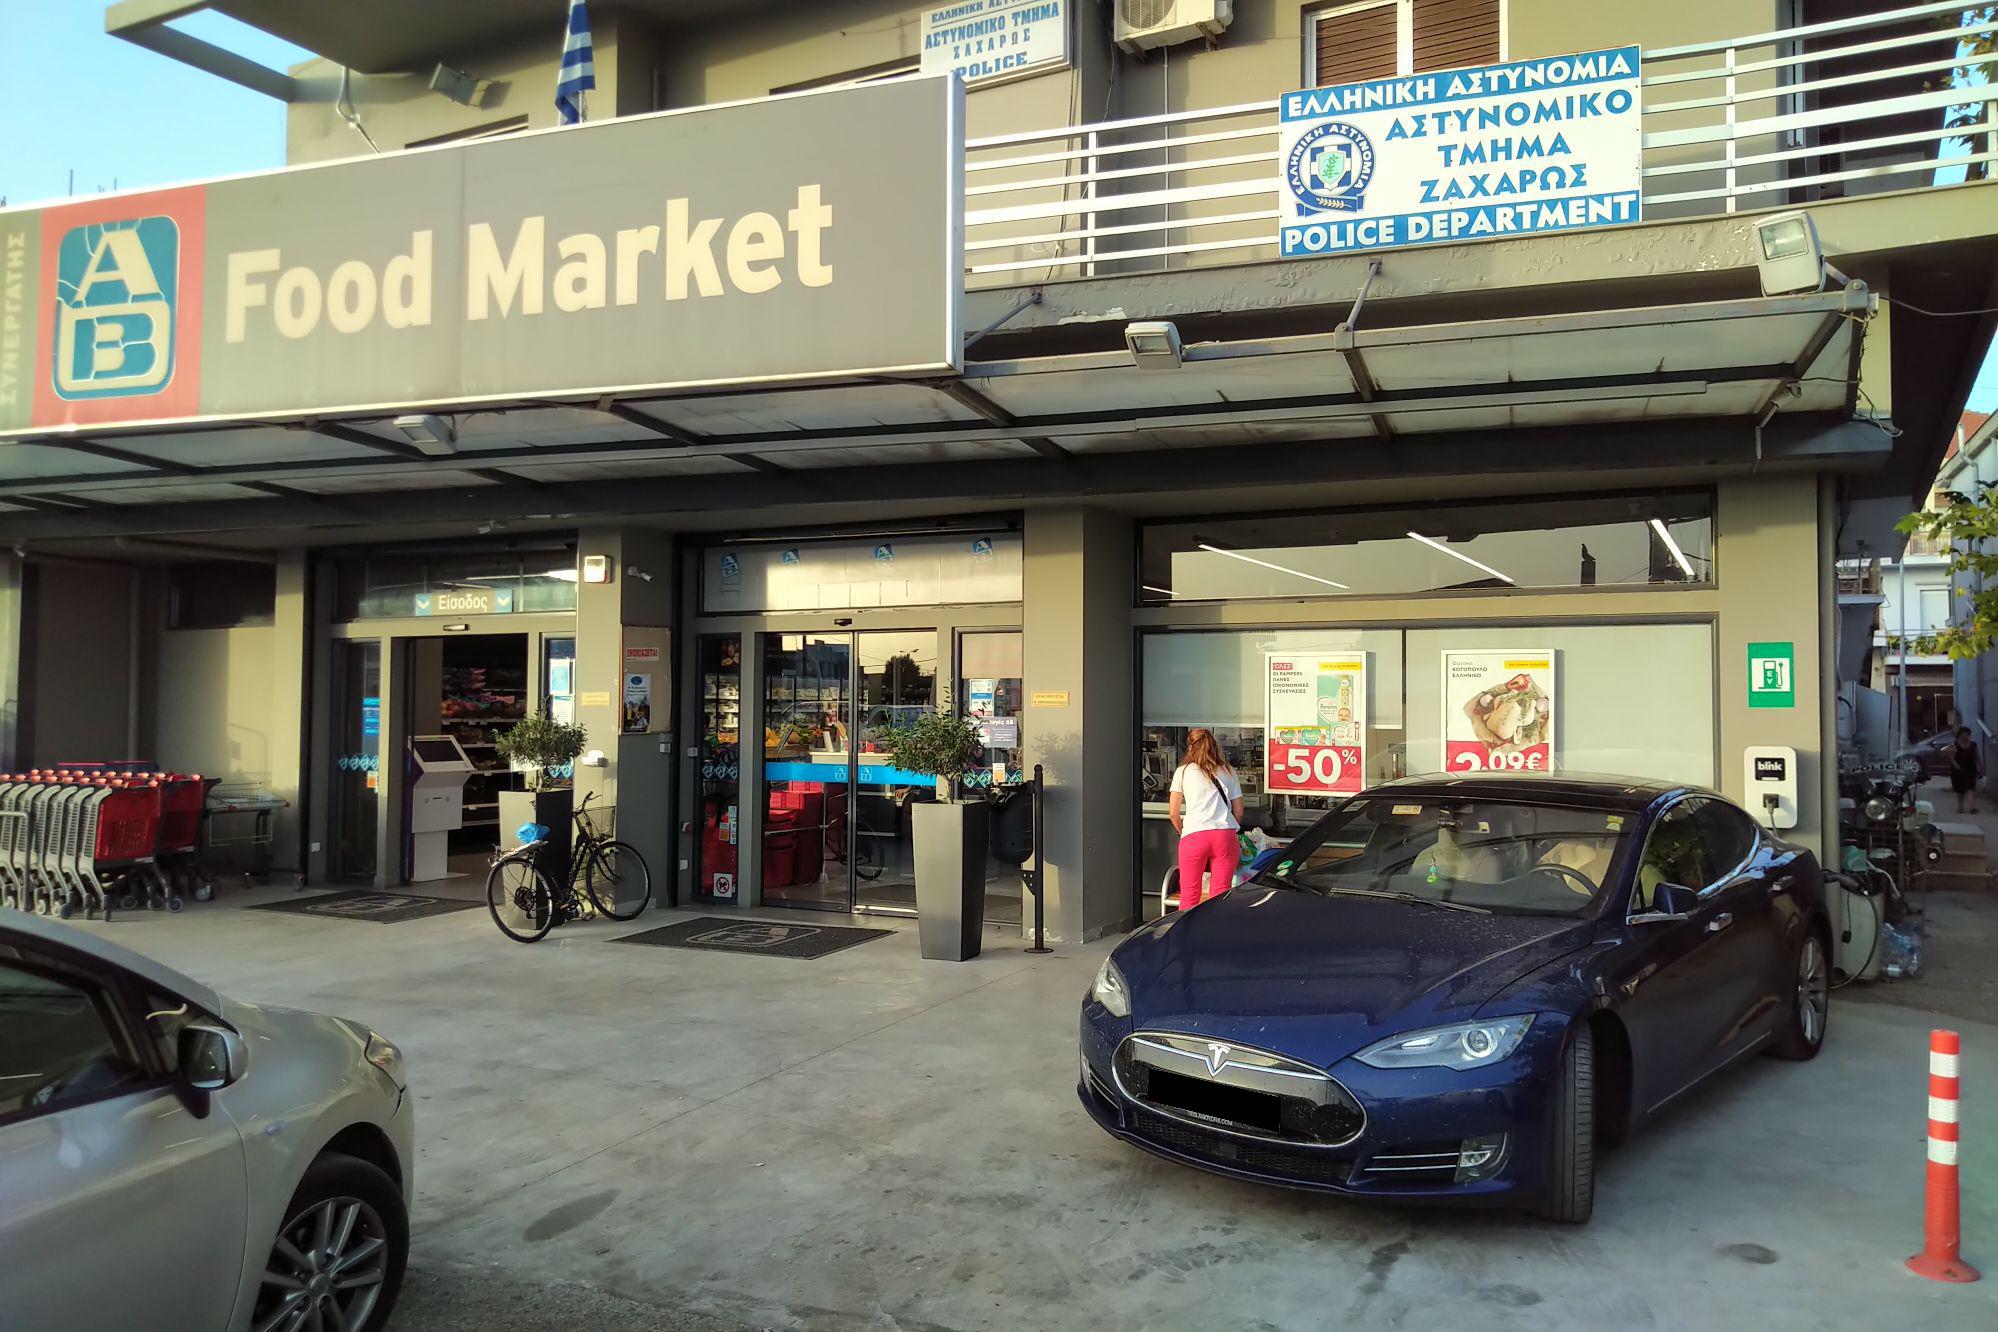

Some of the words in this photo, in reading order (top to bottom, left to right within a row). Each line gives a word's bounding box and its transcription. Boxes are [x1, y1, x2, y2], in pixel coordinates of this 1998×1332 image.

[925, 15, 1006, 50] ΑΣΤΥΝΟΜΙΚΟ
[1011, 1, 1060, 27] ΤΜΗΜΑ
[931, 2, 983, 24] ΕΛΛΗΝΙΚΗ
[953, 28, 1031, 60] ΖΑΧΑΡΩΣ
[955, 51, 1028, 80] POLICE
[1288, 77, 1436, 118] ΕΛΛΗΝΙΚΗ
[1446, 52, 1632, 97] ΑΣΤΥΝΟΜΙΑ
[1384, 88, 1633, 142] ΑΣΤΥΝΟΜΙΚΟ
[1289, 126, 1324, 195] ΕΛΛΗΝΙΚΗ
[1328, 124, 1373, 190] ΑΣΤΥΝΟΜΙΑ
[1437, 131, 1572, 168] ΤΜΗΜΑ
[1418, 162, 1588, 204] ΖΑΧΑΡΩΣ
[1284, 217, 1395, 254] POLICE
[1407, 193, 1637, 242] DEPARTMENT
[225, 229, 433, 344] Food
[467, 183, 833, 321] Market
[439, 594, 488, 613] Είσοδος
[1273, 748, 1358, 785] -50%
[1455, 750, 1543, 771] 209€
[1757, 761, 1783, 771] blink
